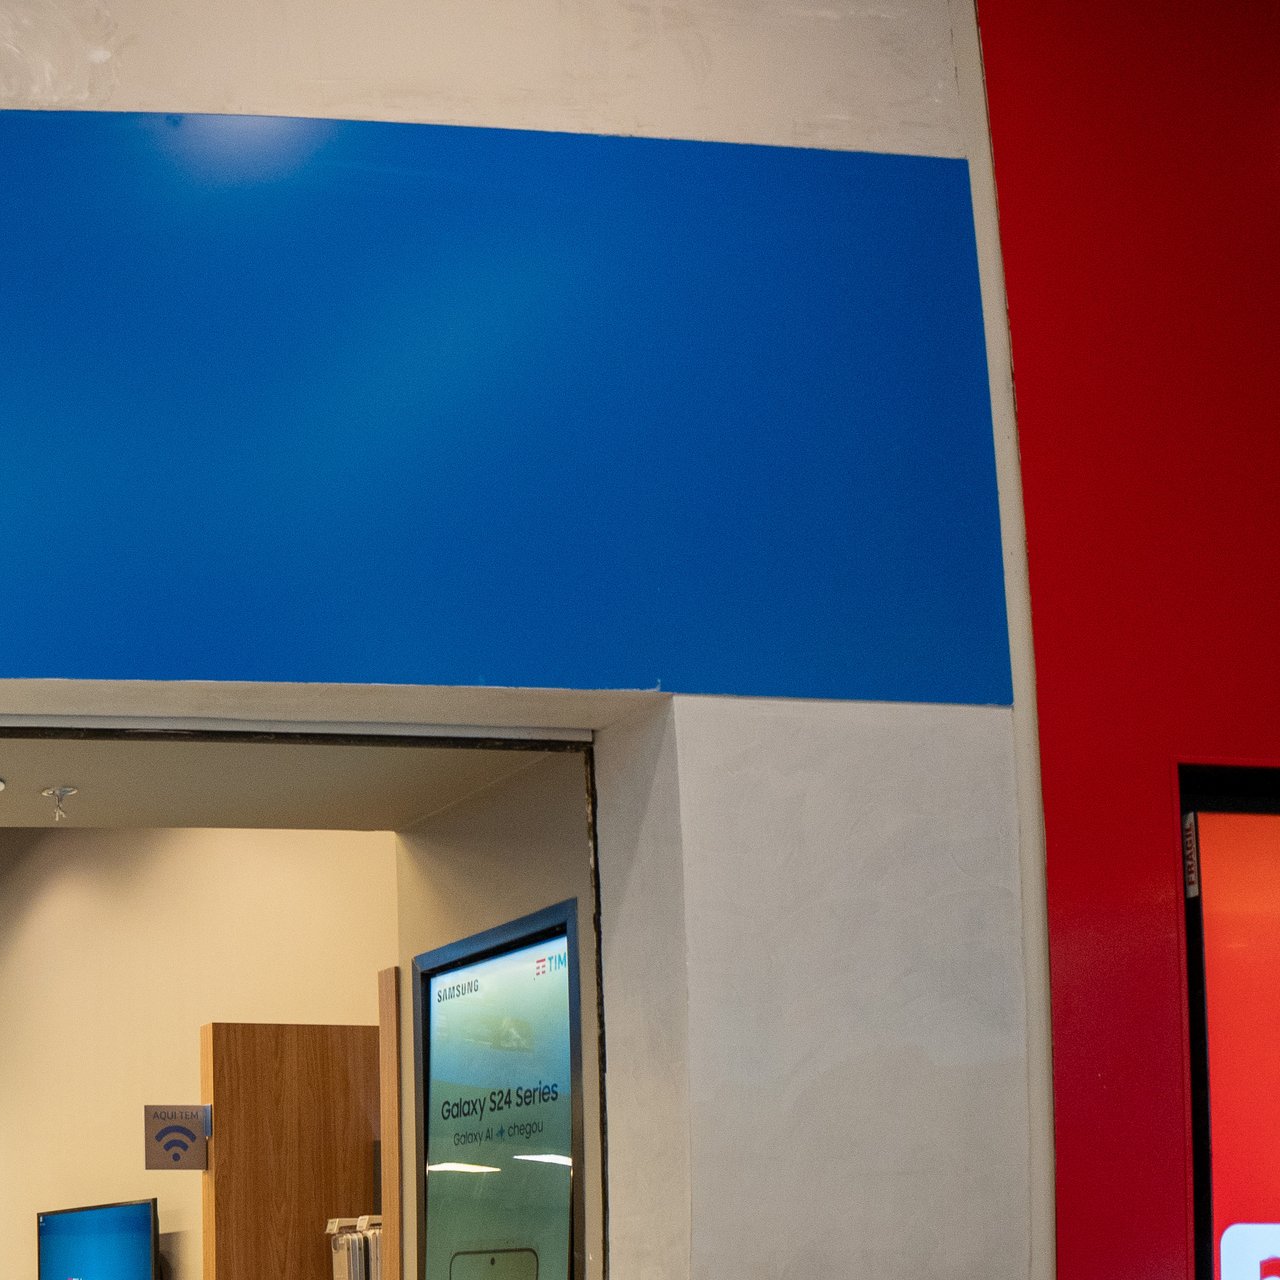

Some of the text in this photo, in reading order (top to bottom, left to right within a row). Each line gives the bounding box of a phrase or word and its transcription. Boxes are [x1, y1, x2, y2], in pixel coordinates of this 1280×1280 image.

[437, 952, 567, 1003] SAMSUNG TIM
[153, 1110, 199, 1121] AQUI TEM
[441, 1081, 559, 1121] Galaxy S24 Series
[453, 1128, 484, 1147] Galaxy
[508, 1118, 544, 1142] chegou
